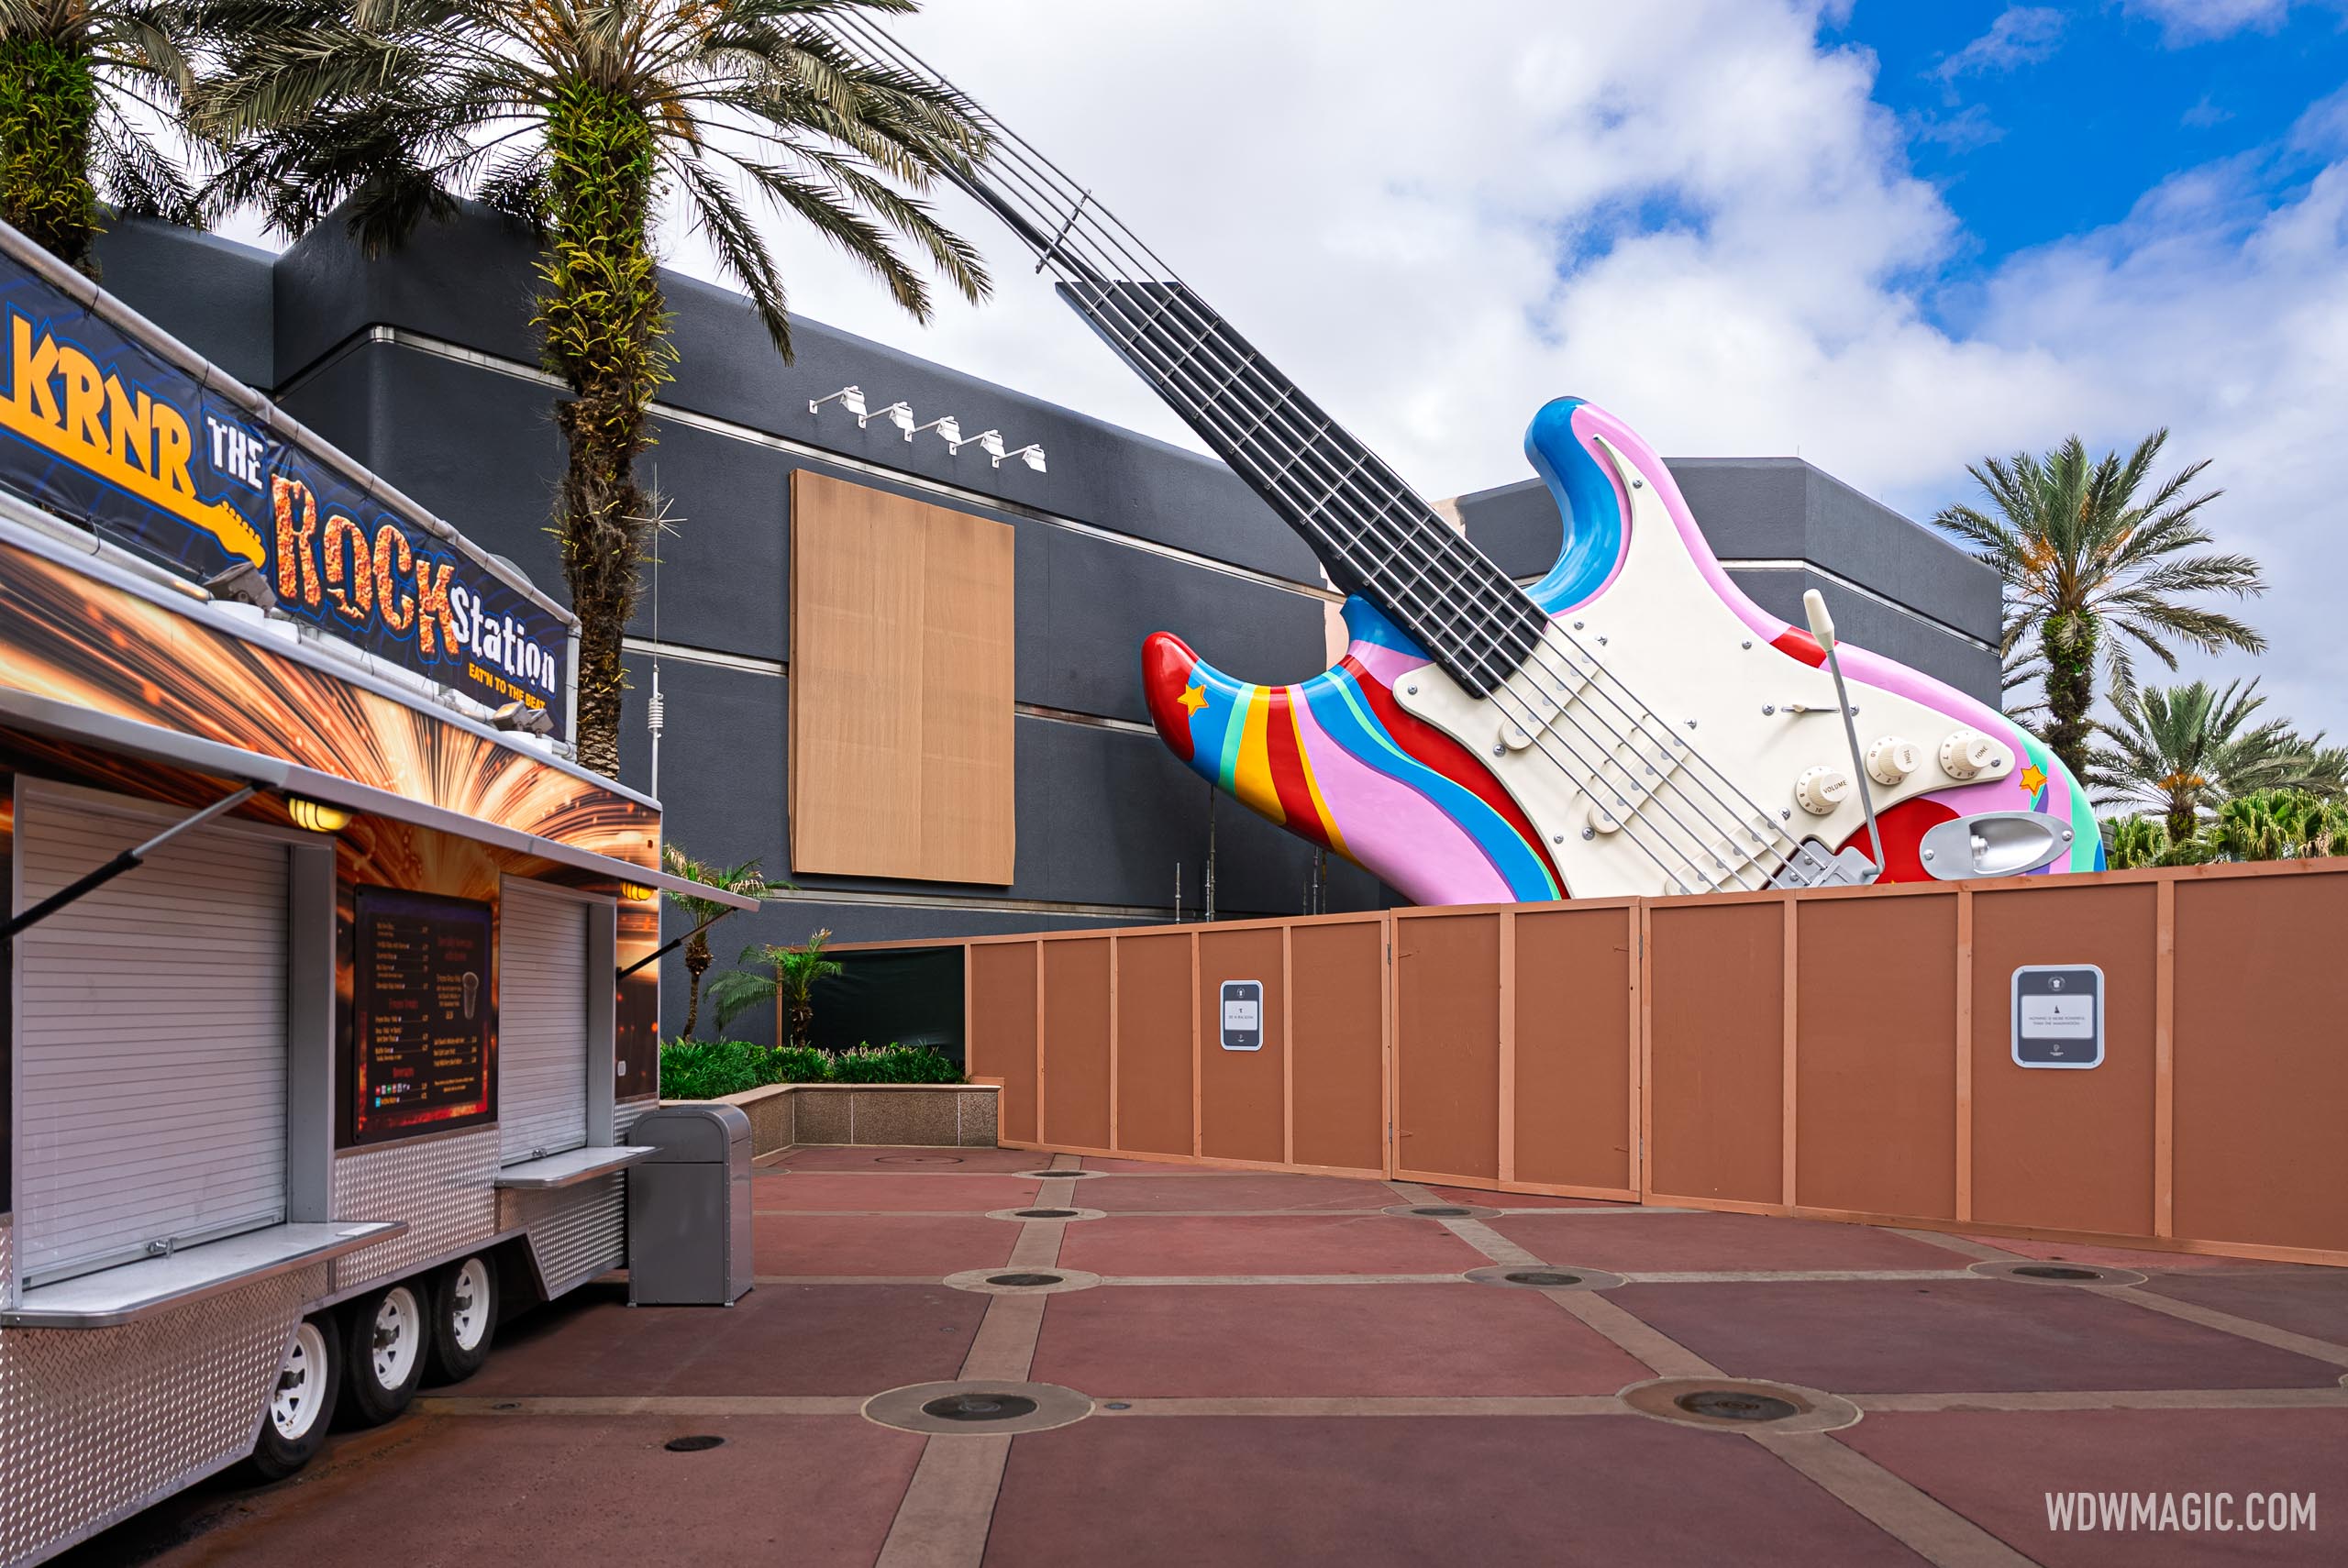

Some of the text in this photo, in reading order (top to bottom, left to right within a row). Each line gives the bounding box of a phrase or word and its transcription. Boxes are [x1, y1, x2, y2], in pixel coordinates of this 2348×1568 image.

[13, 315, 196, 500] KRNR
[207, 416, 264, 490] THE
[450, 586, 557, 694] Station
[469, 662, 546, 710] EAT'N TO THE BEAT
[1903, 748, 1911, 766] TONE
[1975, 745, 1989, 759] TONE
[1822, 779, 1847, 794] VOLUME
